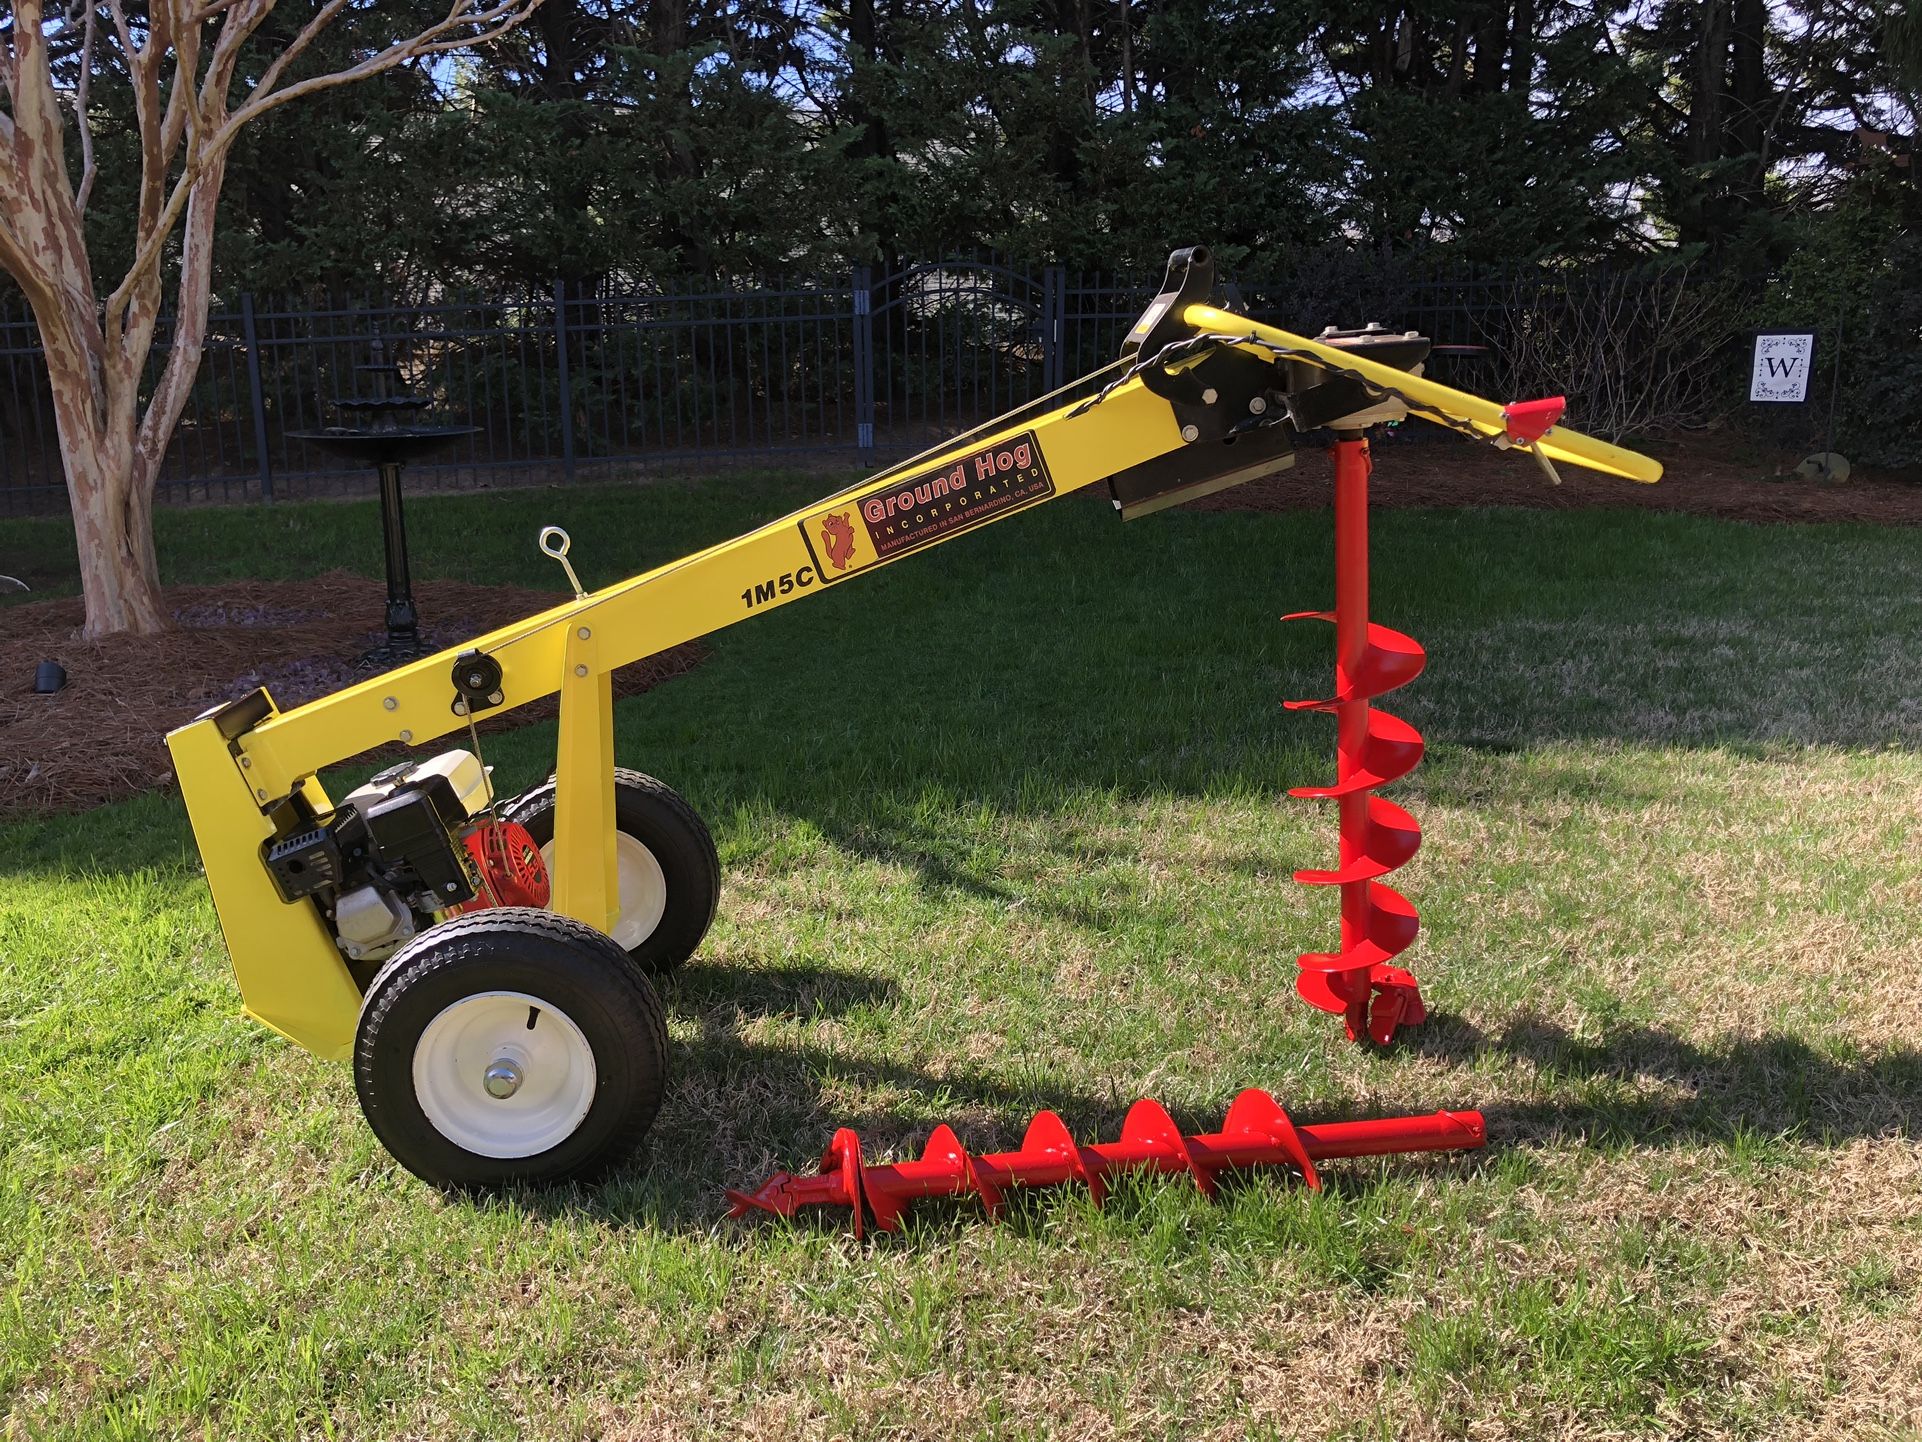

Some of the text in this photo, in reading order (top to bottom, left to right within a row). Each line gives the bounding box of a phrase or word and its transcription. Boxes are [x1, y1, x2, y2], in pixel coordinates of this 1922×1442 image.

[1764, 357, 1800, 378] W
[863, 443, 1032, 523] Ground Hog
[874, 468, 1039, 540] INCORPORATED
[880, 523, 938, 552] MANUFACTURED
[939, 519, 948, 529] IN
[948, 513, 964, 525] SAN
[1028, 481, 1045, 492] USA
[741, 566, 814, 609] 1M5C
